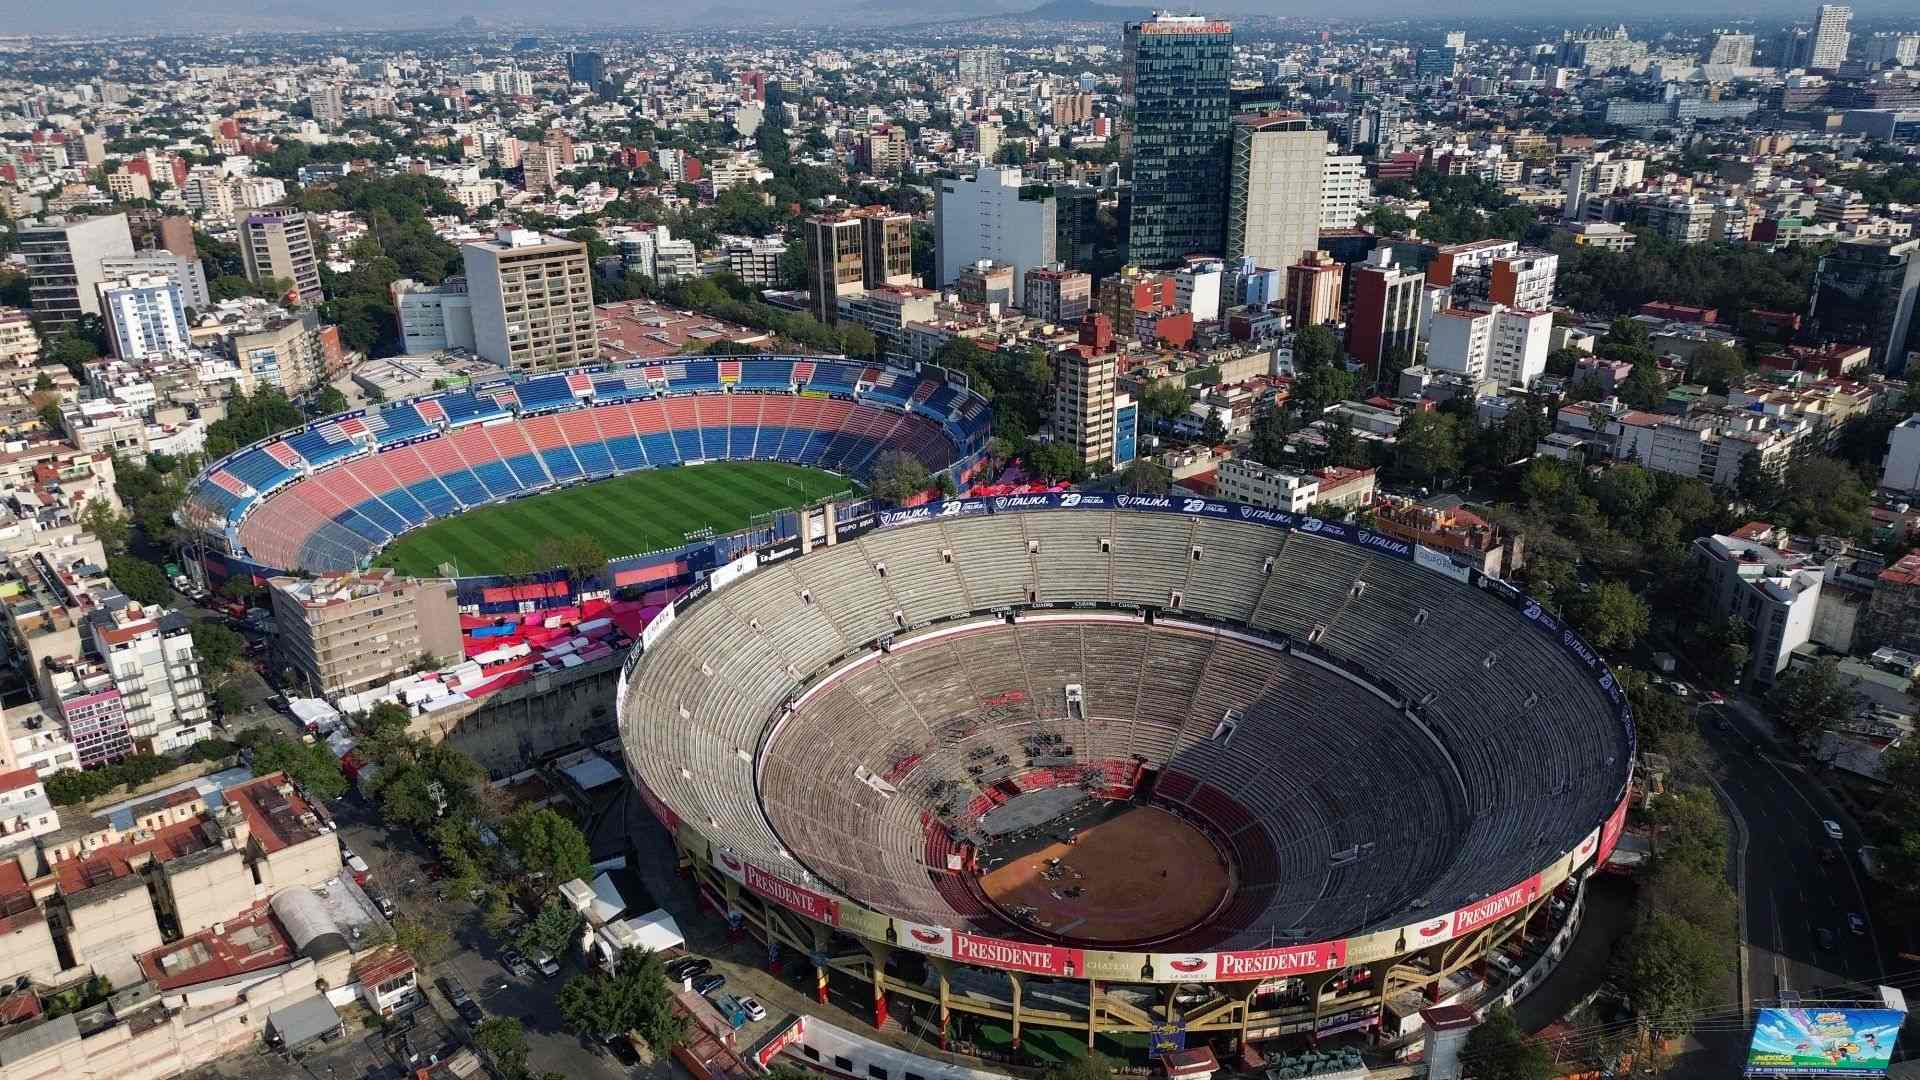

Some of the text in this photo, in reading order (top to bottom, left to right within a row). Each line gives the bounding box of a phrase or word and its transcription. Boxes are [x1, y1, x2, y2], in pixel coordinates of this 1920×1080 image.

[1007, 496, 1046, 506] ITALIKA
[1128, 496, 1169, 507] ITALIKA
[891, 507, 929, 522] ITALIKA
[1252, 509, 1291, 524] ITALIKA
[1367, 535, 1409, 554] ITALIKA
[1569, 640, 1596, 668] ITALIKA
[749, 866, 816, 913] PRESIDENTE
[1456, 889, 1524, 930] PRESIDENTE
[957, 935, 1053, 969] PRESIDENTE
[1222, 950, 1316, 974] PRESIDENTE
